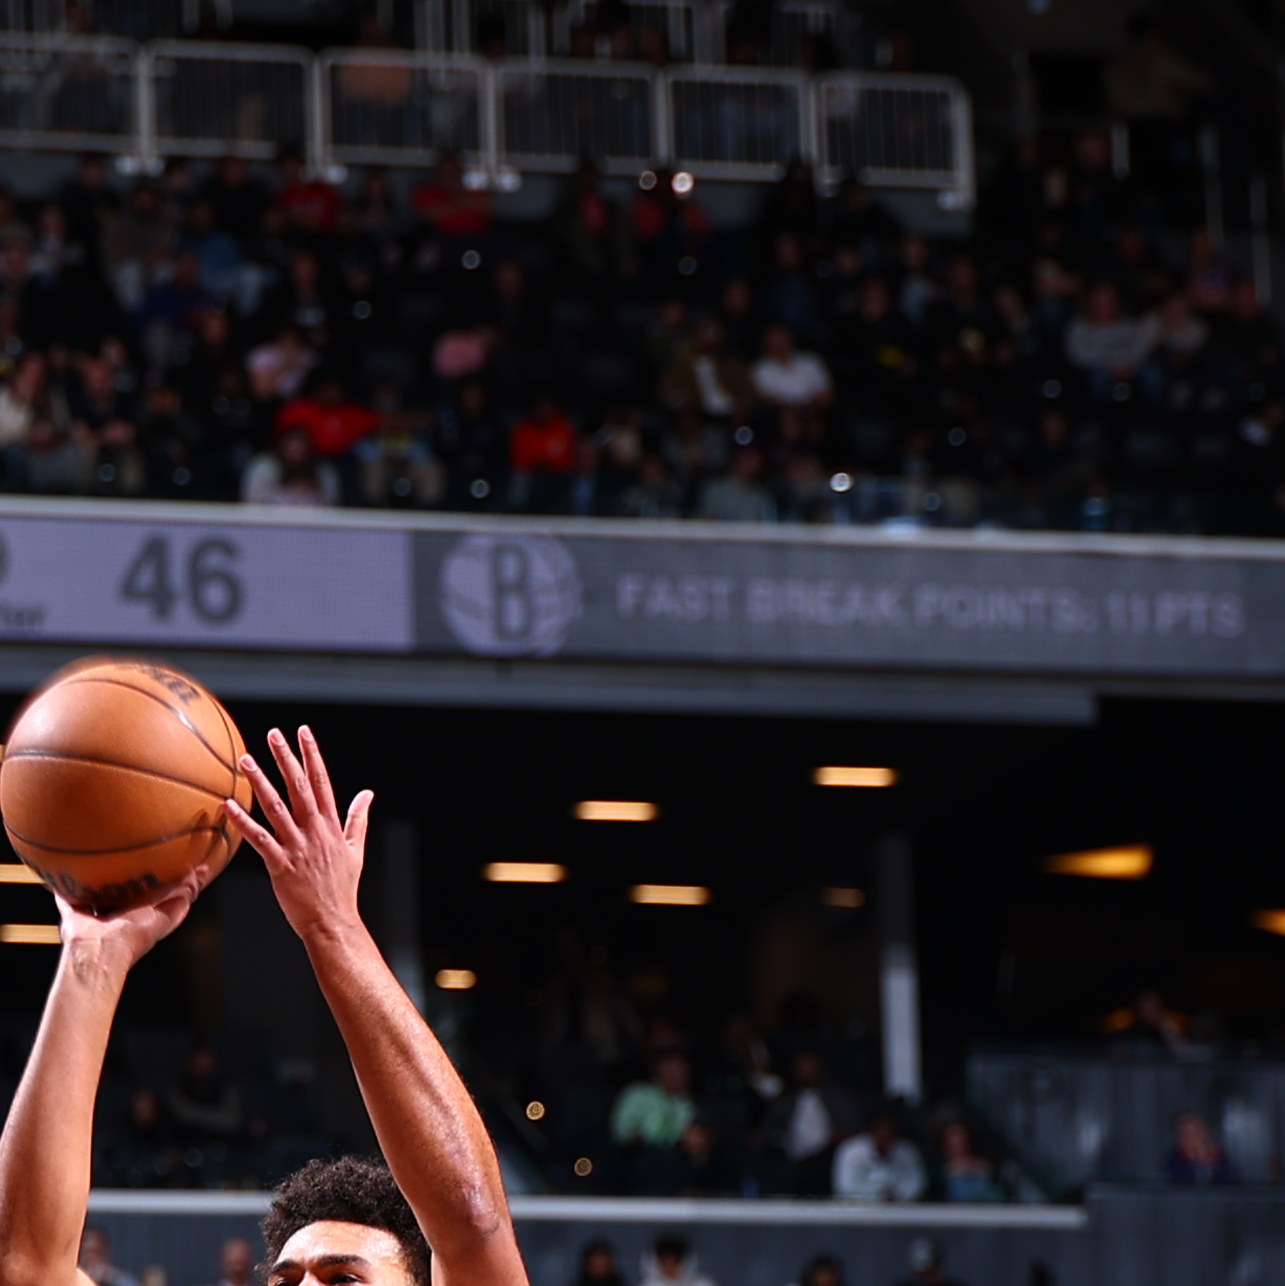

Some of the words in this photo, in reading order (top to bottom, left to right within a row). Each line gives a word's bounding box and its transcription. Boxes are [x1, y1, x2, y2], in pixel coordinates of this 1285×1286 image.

[121, 535, 245, 624] 46
[615, 573, 729, 622] FAST
[746, 578, 905, 627] BREAK
[1156, 592, 1245, 639] PTS
